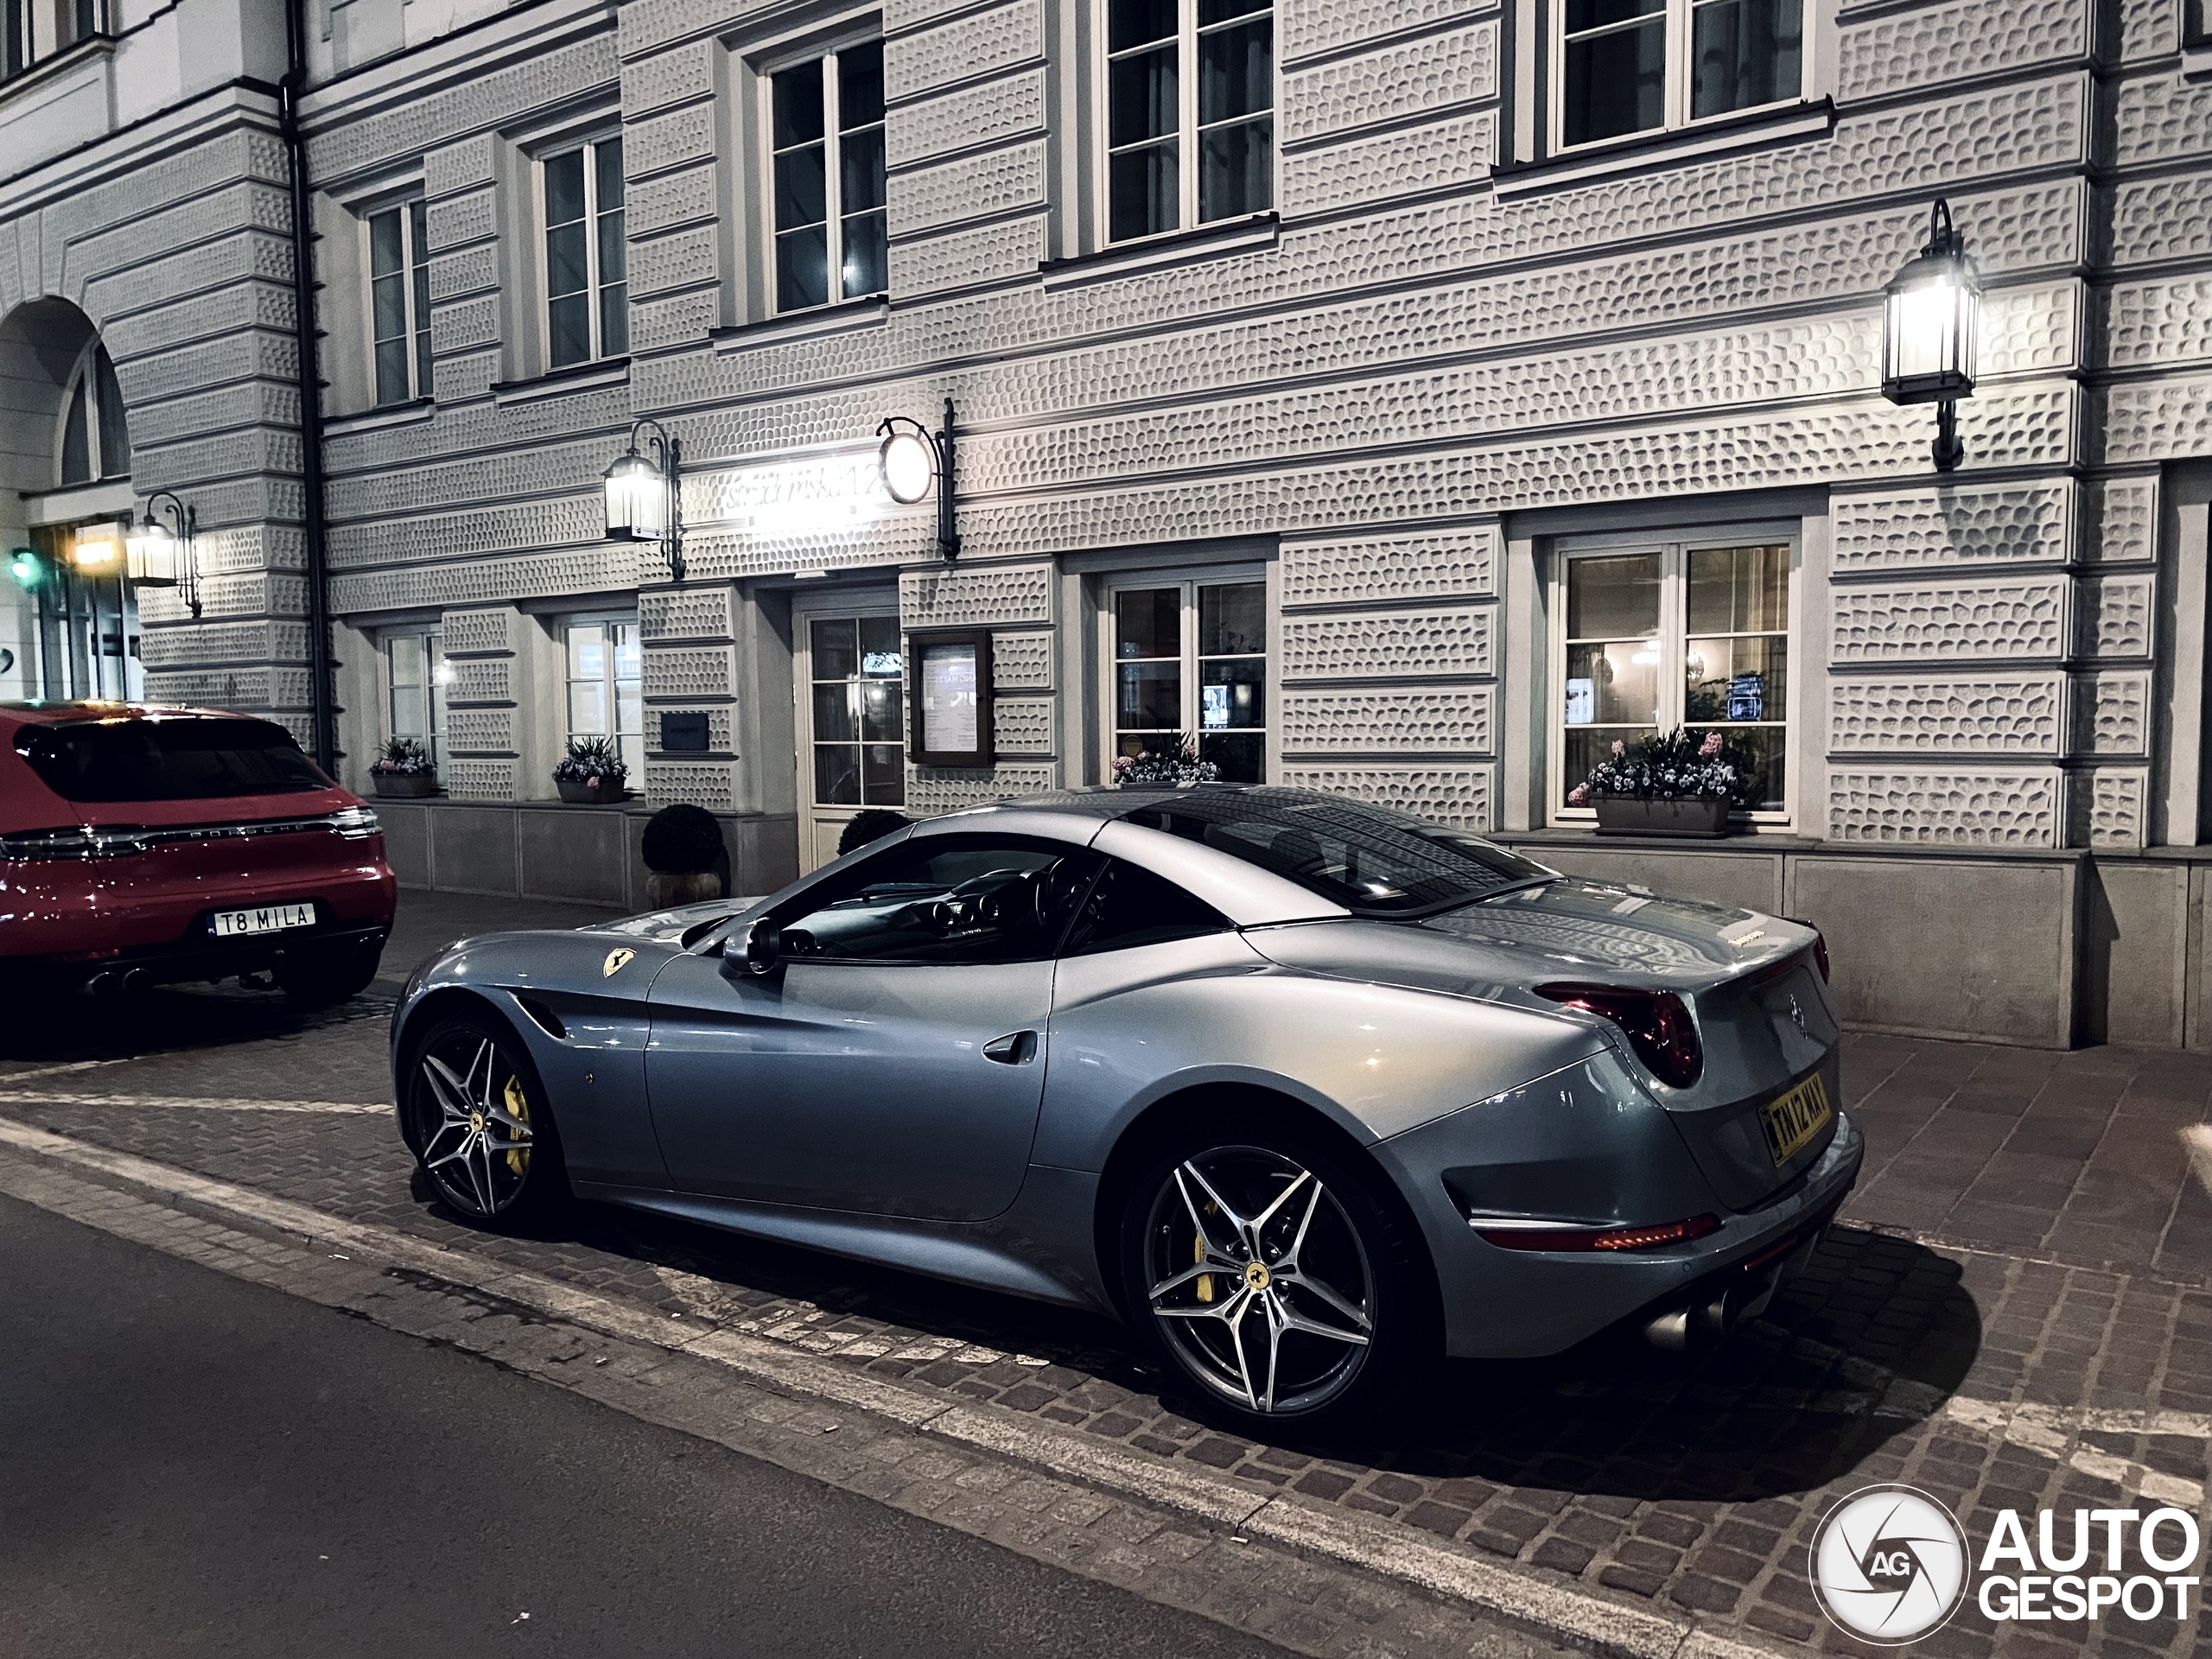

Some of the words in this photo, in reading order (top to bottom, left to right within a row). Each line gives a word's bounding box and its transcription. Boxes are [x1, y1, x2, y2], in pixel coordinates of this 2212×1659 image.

[190, 824, 304, 838] PORSCHE
[221, 912, 247, 933] T8
[257, 906, 308, 929] MILA
